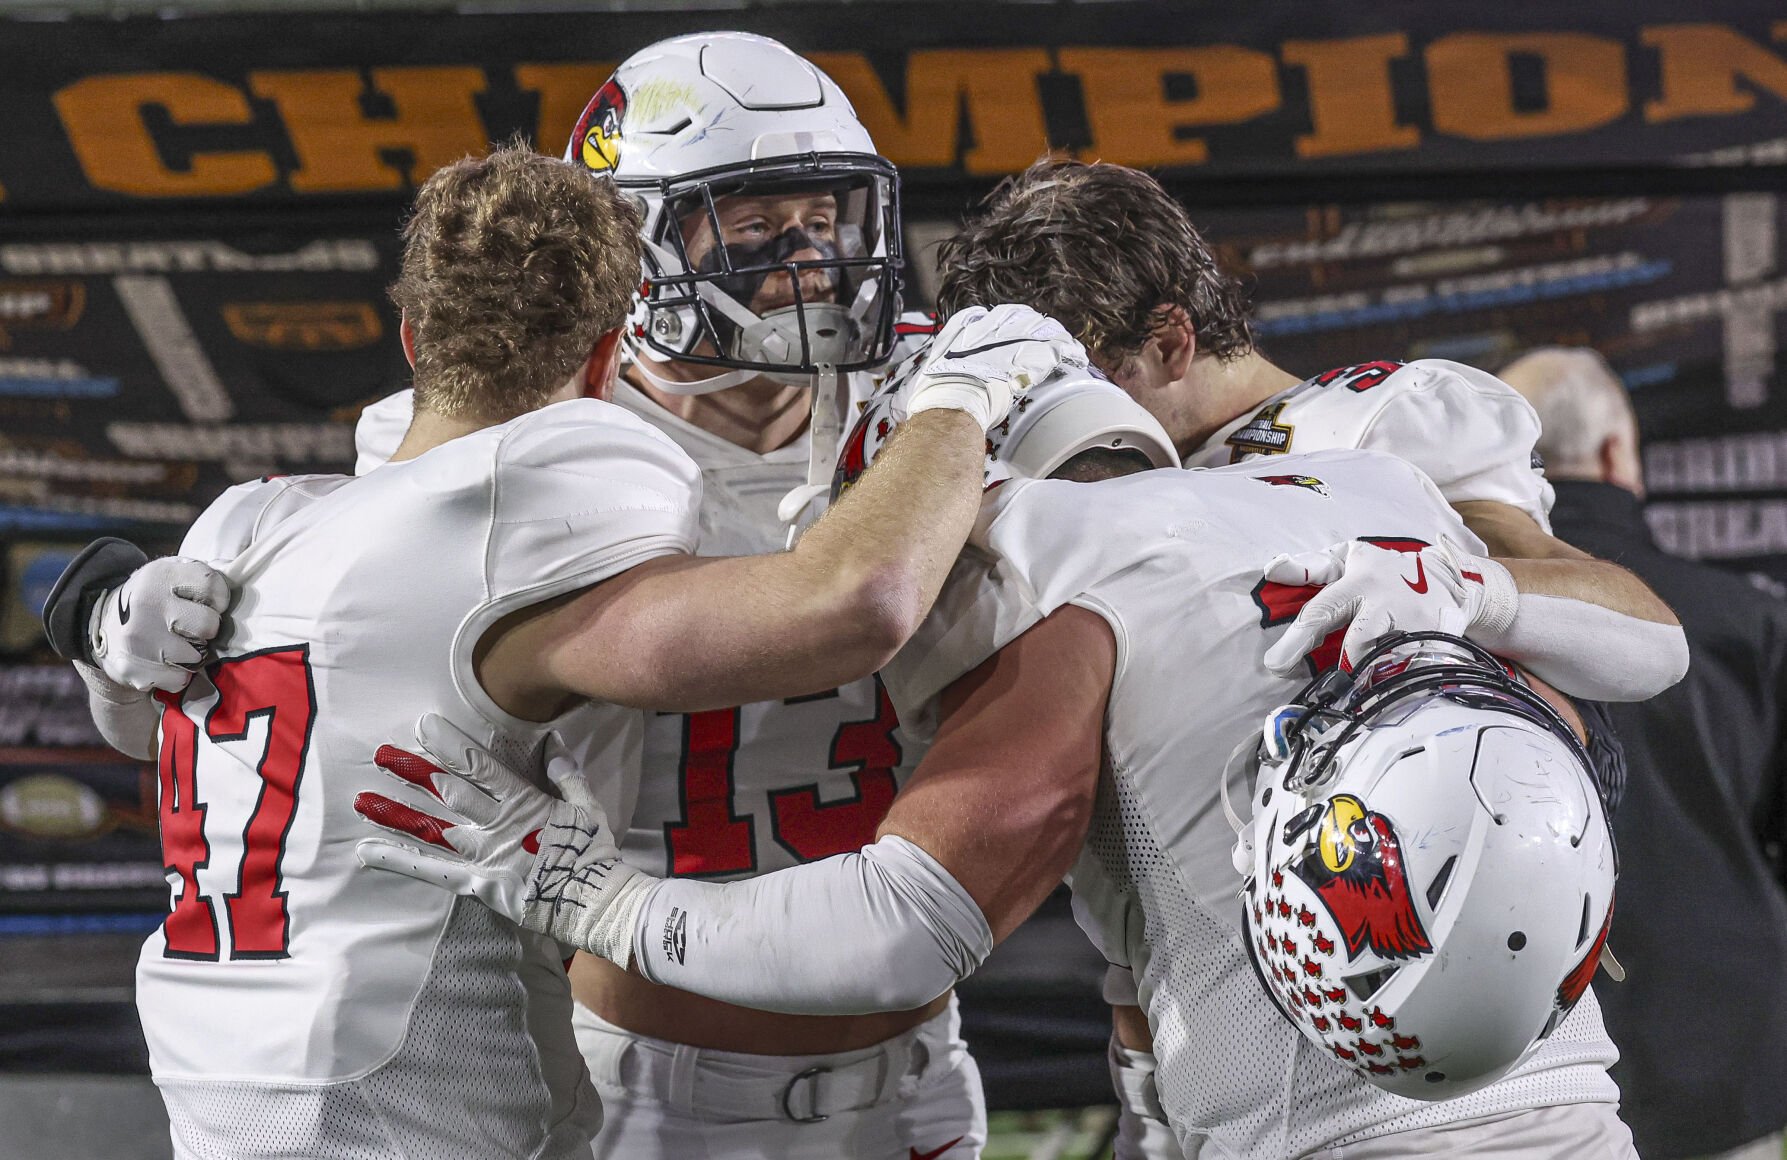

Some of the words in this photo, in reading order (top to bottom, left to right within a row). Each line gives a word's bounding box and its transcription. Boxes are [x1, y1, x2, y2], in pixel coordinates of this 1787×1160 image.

[52, 21, 1787, 197] CHMPION
[156, 642, 318, 961] 47
[656, 670, 903, 879] 13
